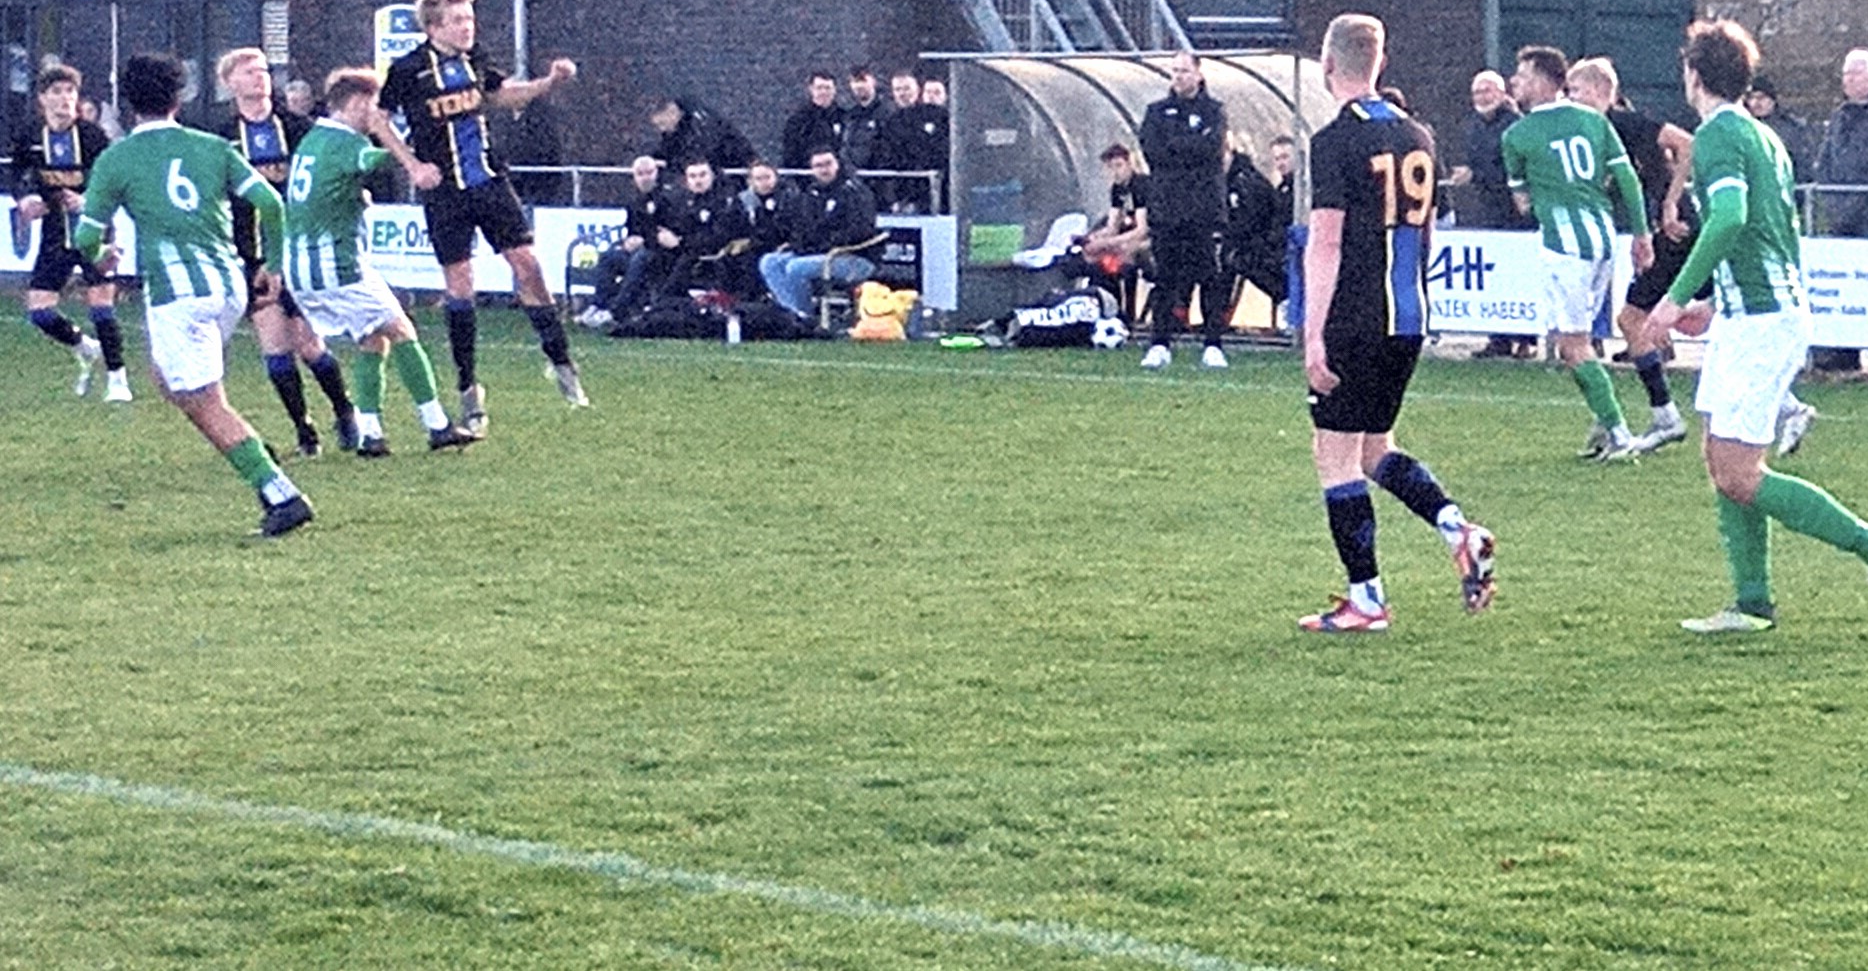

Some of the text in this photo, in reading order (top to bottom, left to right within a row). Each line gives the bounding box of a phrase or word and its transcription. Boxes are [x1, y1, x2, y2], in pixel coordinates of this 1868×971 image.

[166, 158, 200, 212] 6
[287, 153, 316, 202] 15
[1550, 135, 1597, 184] 10
[1372, 151, 1435, 228] 19
